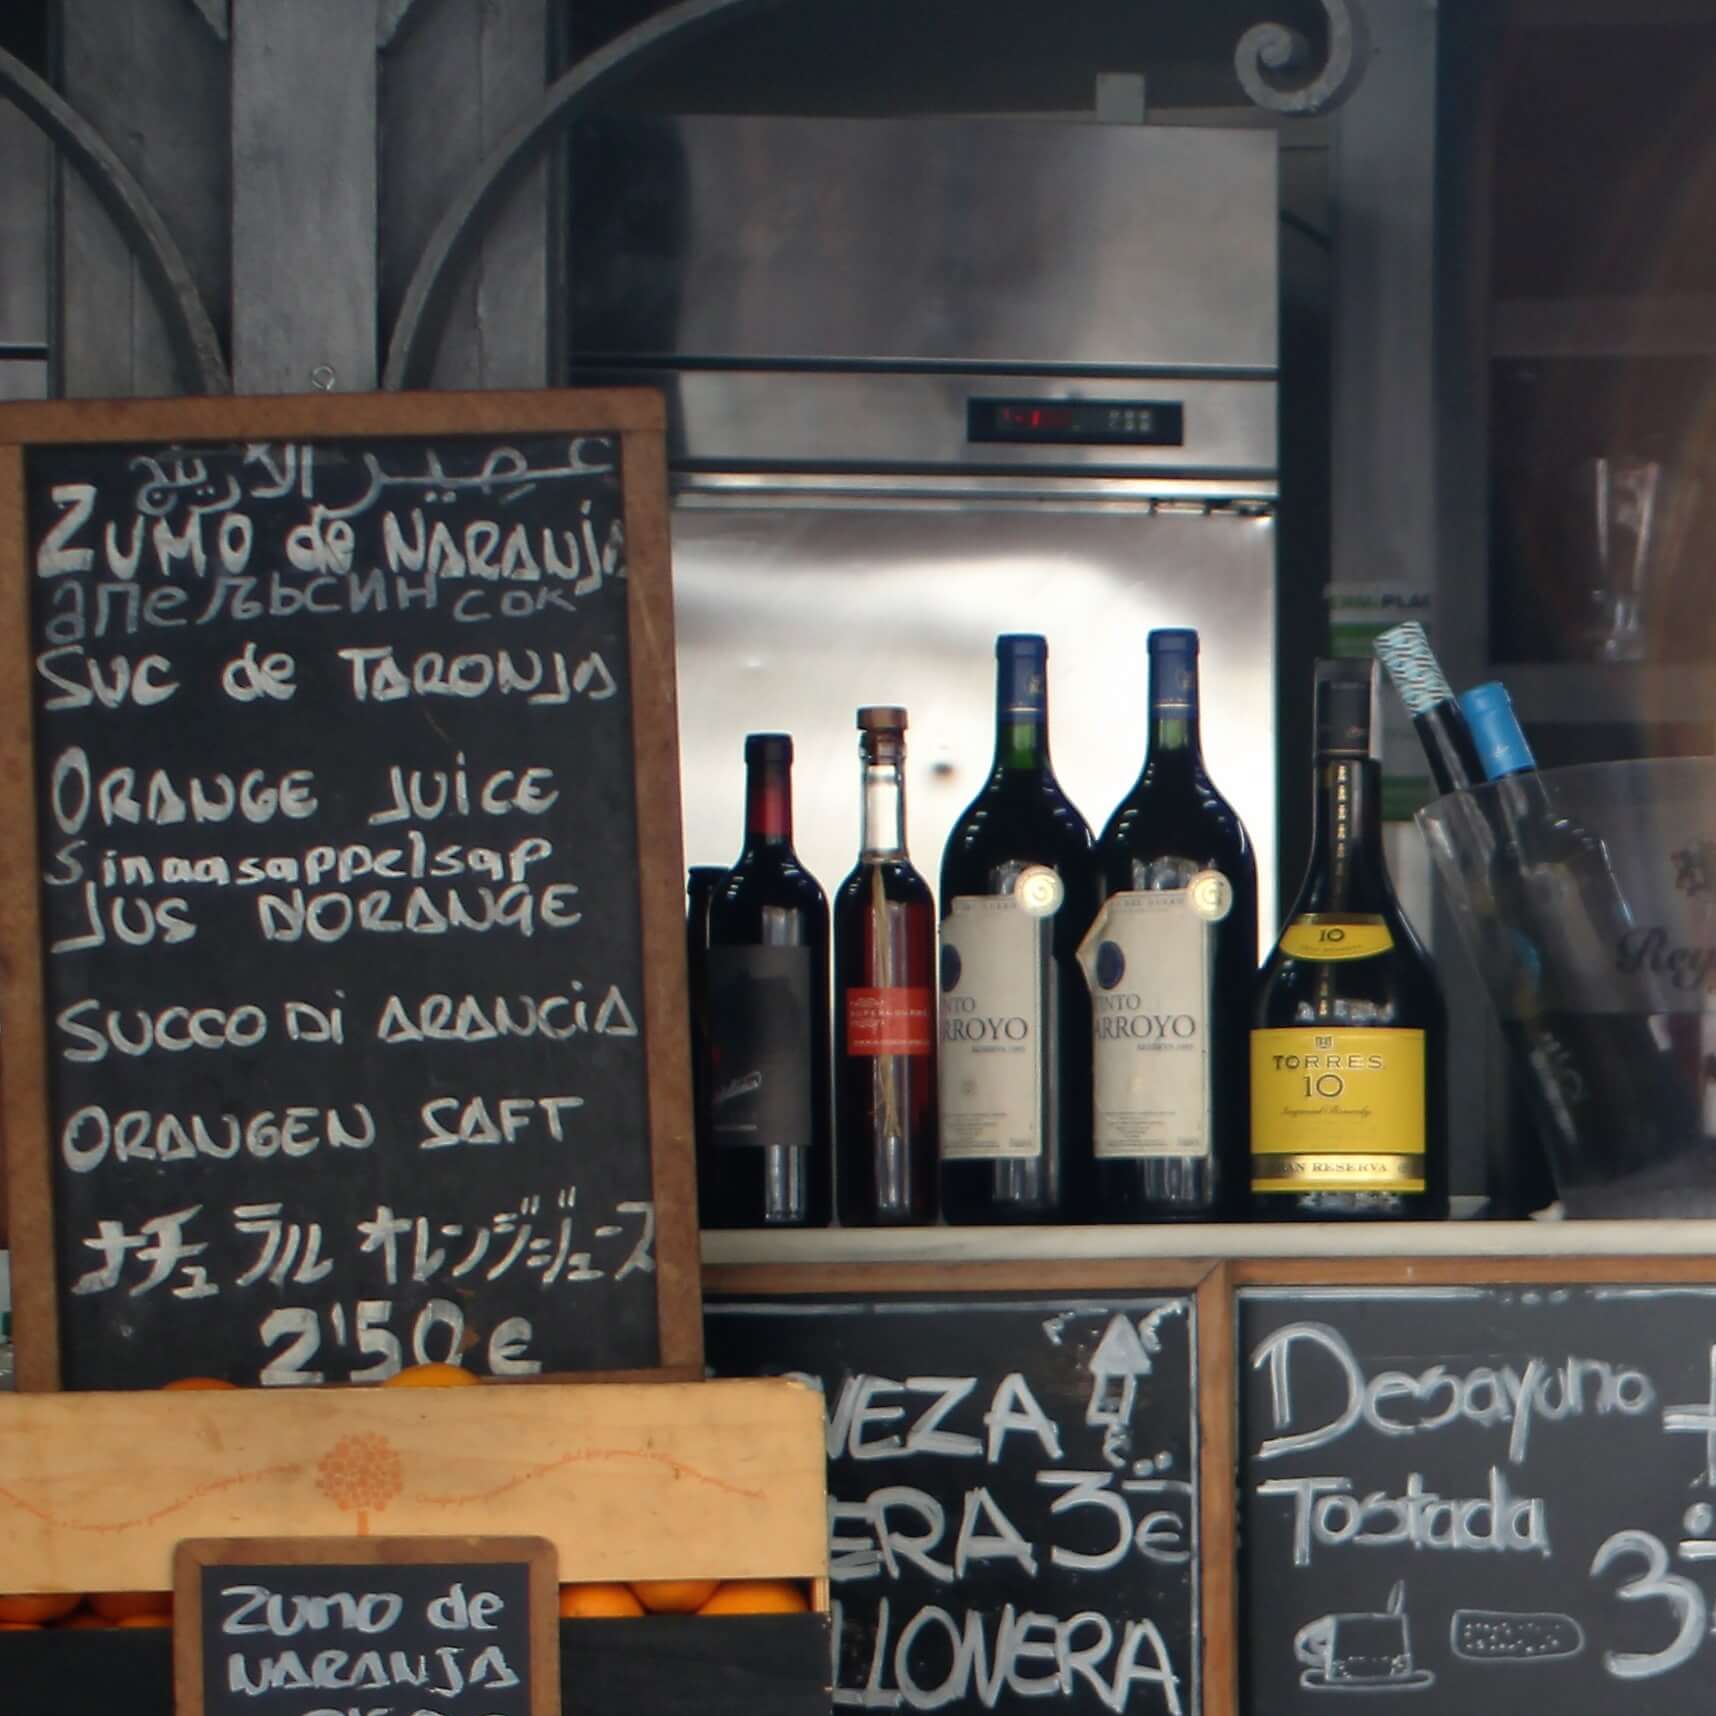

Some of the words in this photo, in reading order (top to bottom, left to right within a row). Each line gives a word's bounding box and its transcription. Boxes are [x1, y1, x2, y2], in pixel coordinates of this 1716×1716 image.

[37, 484, 253, 579] ZUMO
[287, 505, 355, 575] de
[454, 588, 577, 621] сок
[37, 645, 180, 711] SUC
[223, 641, 298, 701] de
[337, 646, 618, 705] TARONJA
[52, 747, 318, 835] ORANGE
[369, 752, 560, 824] JUICE
[45, 831, 553, 886] Sinaasappelsap
[51, 881, 197, 954] JUS
[1319, 928, 1345, 943] 10
[56, 999, 268, 1063] SUCCO
[940, 996, 976, 1014] NTO
[940, 1017, 1029, 1041] RROYO
[1271, 1054, 1384, 1070] TORRES
[1303, 1074, 1344, 1098] 10
[61, 1104, 376, 1173] ORANGEN
[420, 1096, 584, 1151] SAFT
[1312, 1162, 1388, 1173] RESERVA
[824, 1372, 1064, 1465] VEZA
[1252, 1320, 1658, 1464] Desayuno
[828, 1486, 1038, 1584] ERA
[1256, 1466, 1552, 1567] Tostada
[427, 1580, 504, 1632] de
[228, 1645, 521, 1698] NARANJA
